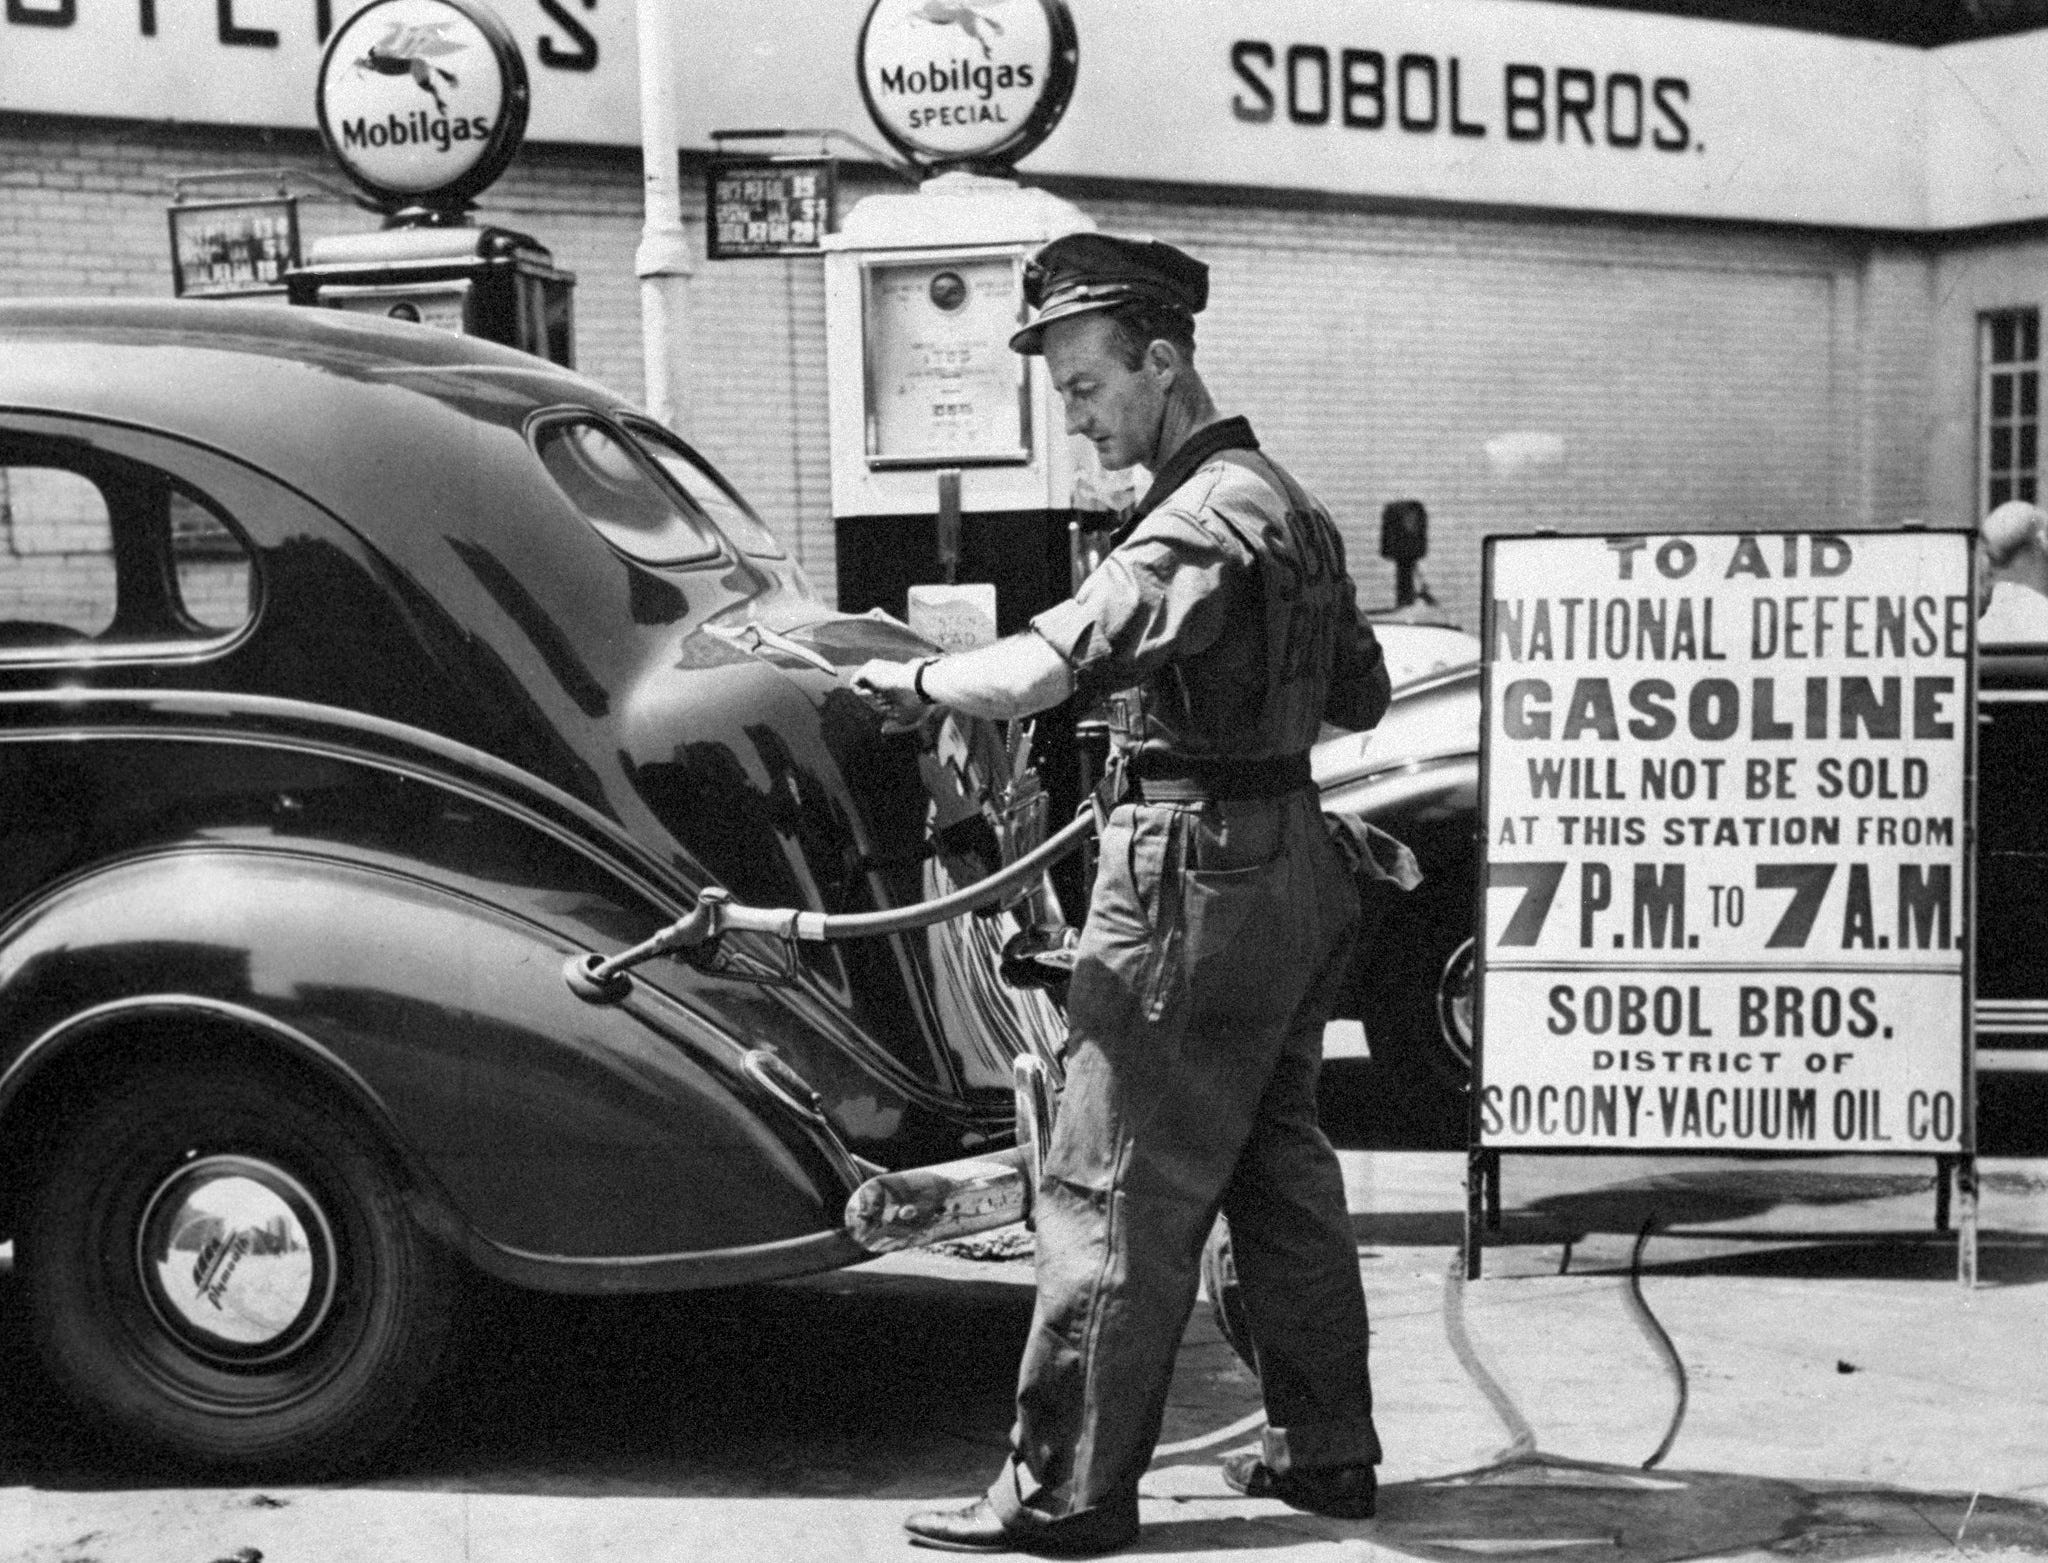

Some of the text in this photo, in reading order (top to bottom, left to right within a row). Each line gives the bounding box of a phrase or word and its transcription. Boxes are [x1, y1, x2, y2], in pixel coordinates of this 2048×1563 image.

[880, 58, 1034, 100] Mobilgas
[1230, 40, 1704, 153] SOBOL BROS.
[342, 110, 490, 153] Mobilgas
[908, 104, 1008, 130] SPECIAL
[1605, 537, 1851, 579] TO AID
[1494, 596, 1965, 661] NATIONAL DEFENSE
[1503, 676, 1955, 741] GASOLINE
[1529, 758, 1928, 800] WILL NOT BE SOLD
[1499, 816, 1954, 847] AT THIS STATION FROM
[1488, 862, 1960, 950] 7 P.M. TO 7 A.M.
[1548, 985, 1893, 1039] SOBOL BROS.
[1594, 1050, 1853, 1073] DISTRICT OF
[1481, 1085, 1817, 1139] SOCONY-VACUUM
[1833, 1088, 1891, 1142] OIL
